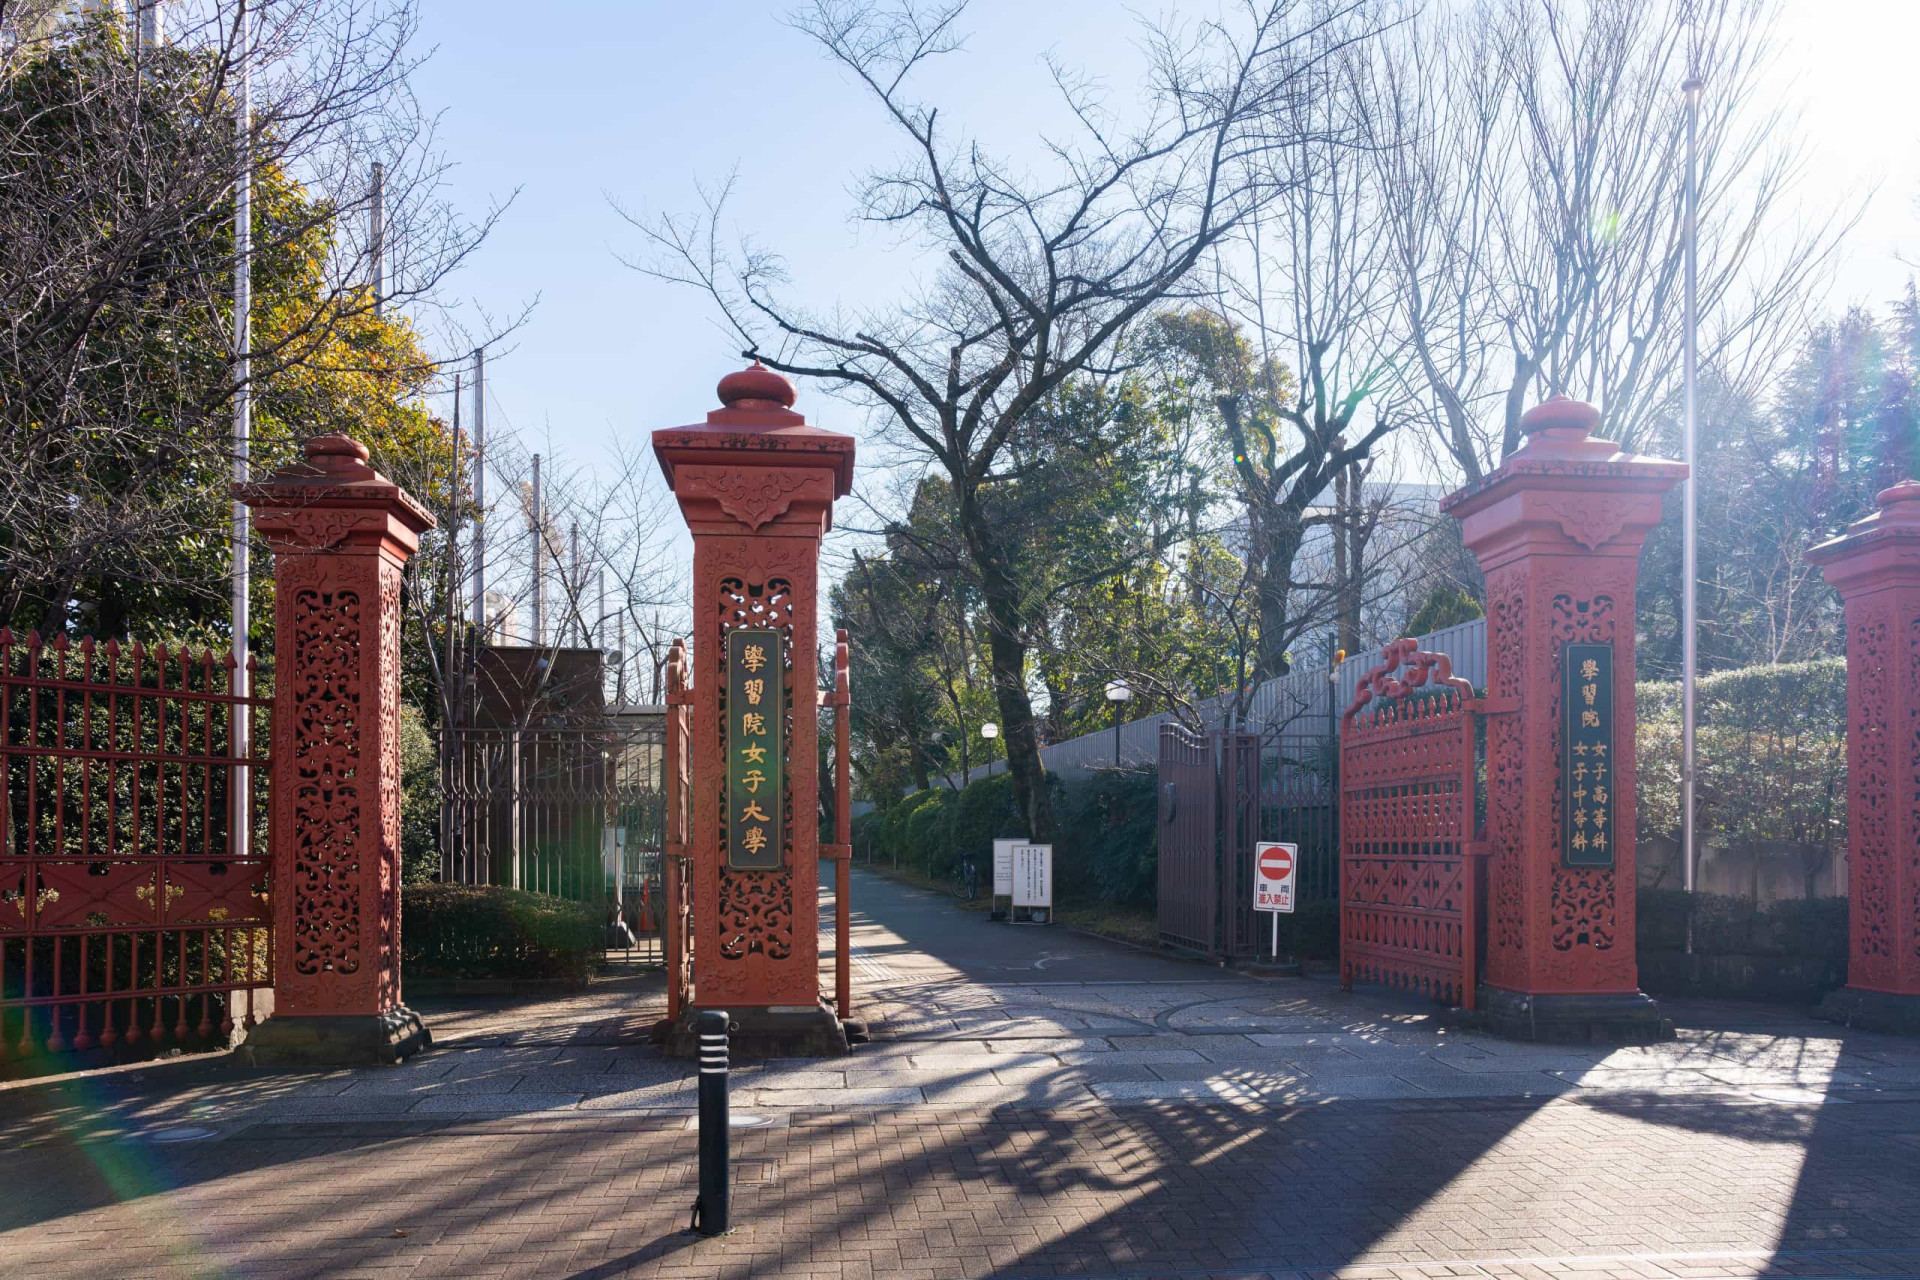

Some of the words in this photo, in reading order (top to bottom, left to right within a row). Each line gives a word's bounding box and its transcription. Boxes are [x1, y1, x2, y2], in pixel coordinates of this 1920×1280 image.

[740, 644, 771, 854] 學習院女子大學
[1580, 658, 1600, 729] 學習院
[1571, 740, 1589, 853] 女子中等科
[1591, 740, 1608, 853] 女子高等科
